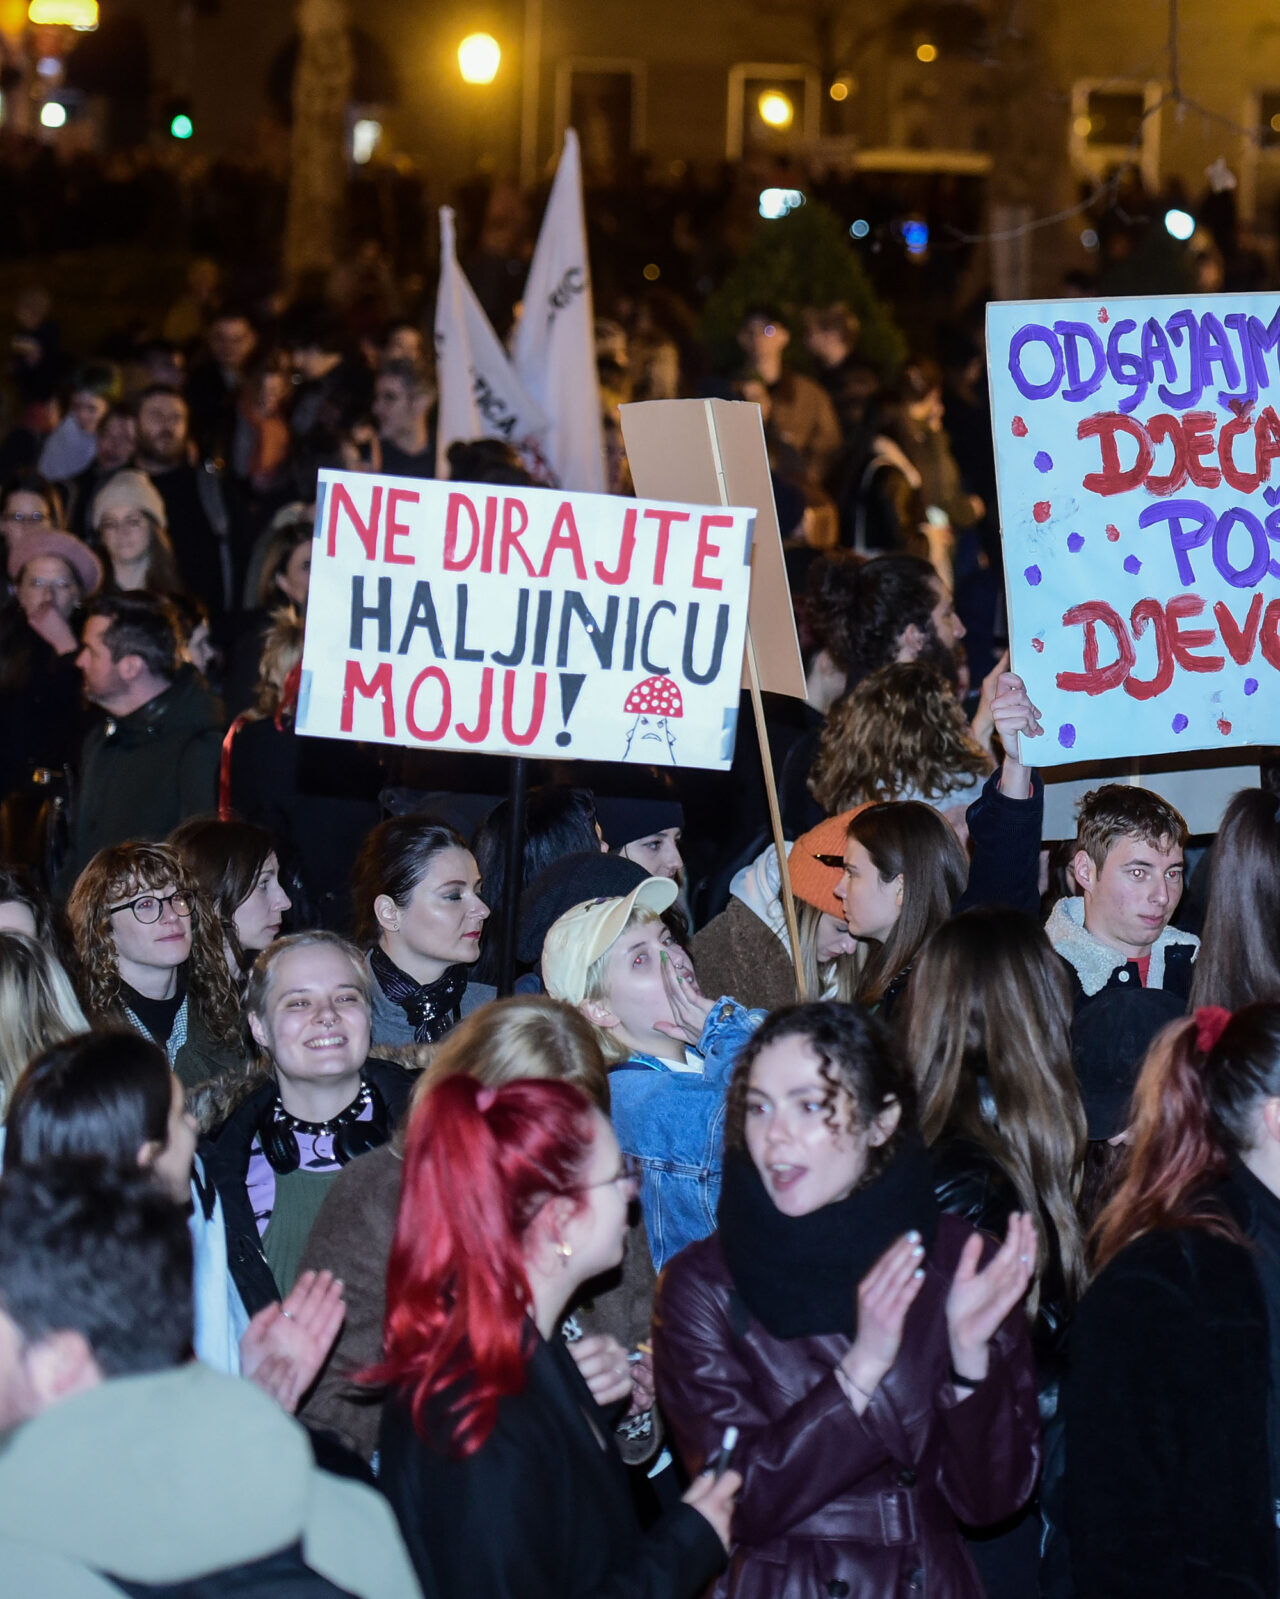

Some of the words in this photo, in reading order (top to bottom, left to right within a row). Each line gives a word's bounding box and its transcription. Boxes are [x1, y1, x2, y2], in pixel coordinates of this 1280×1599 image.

[326, 482, 421, 566] NE
[442, 492, 735, 592] DIRAJTE
[349, 575, 731, 687] HALJINICU
[340, 659, 588, 748] MOJU!
